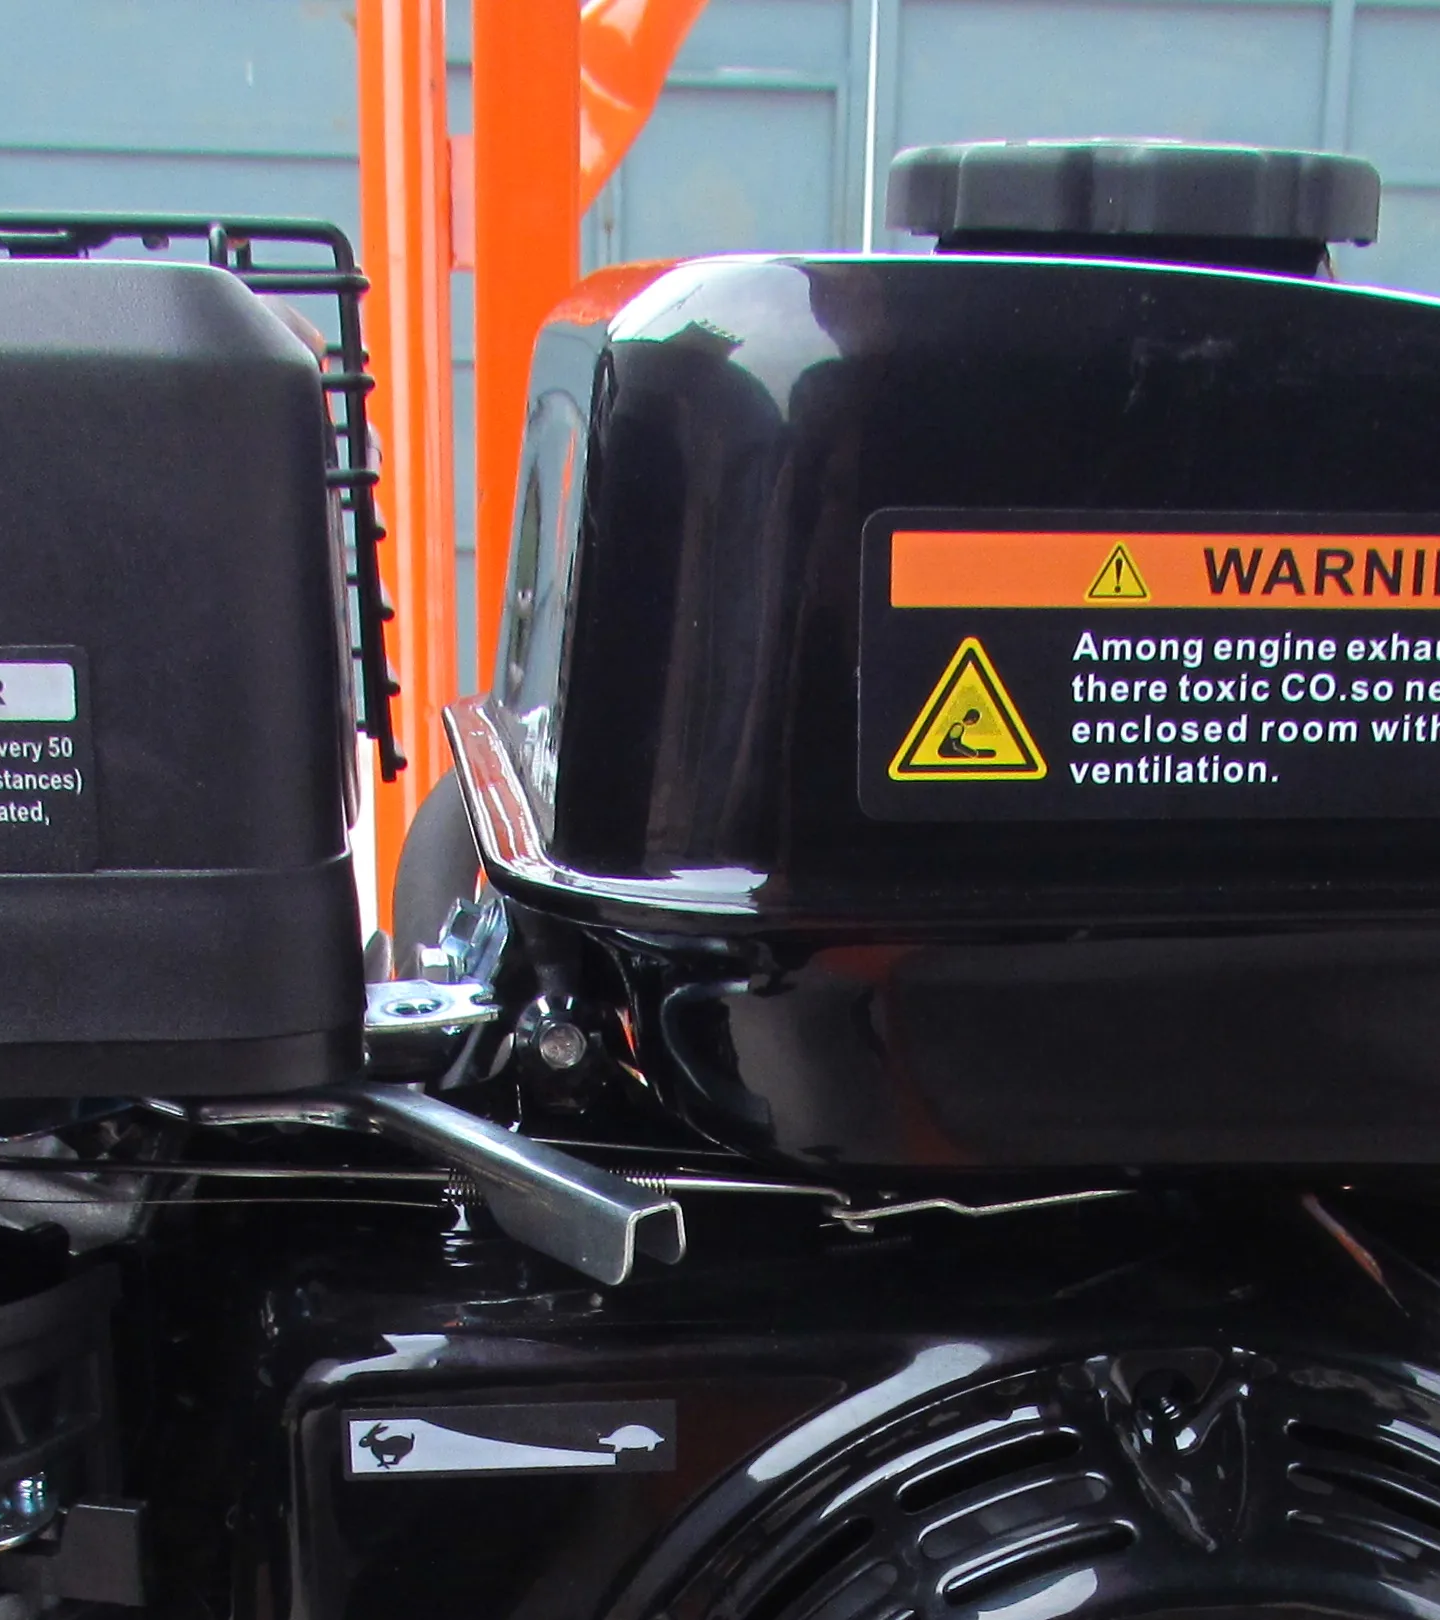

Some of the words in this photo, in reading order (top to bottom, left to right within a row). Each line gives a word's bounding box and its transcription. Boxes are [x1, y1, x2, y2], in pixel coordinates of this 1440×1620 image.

[1072, 631, 1203, 668] Among
[1213, 631, 1337, 668] engine
[1071, 673, 1168, 702] there
[1178, 673, 1270, 702] toxic
[1071, 714, 1248, 743] enclosed
[1261, 720, 1358, 743] room
[48, 737, 73, 758] 50
[1069, 755, 1279, 784] ventilation.
